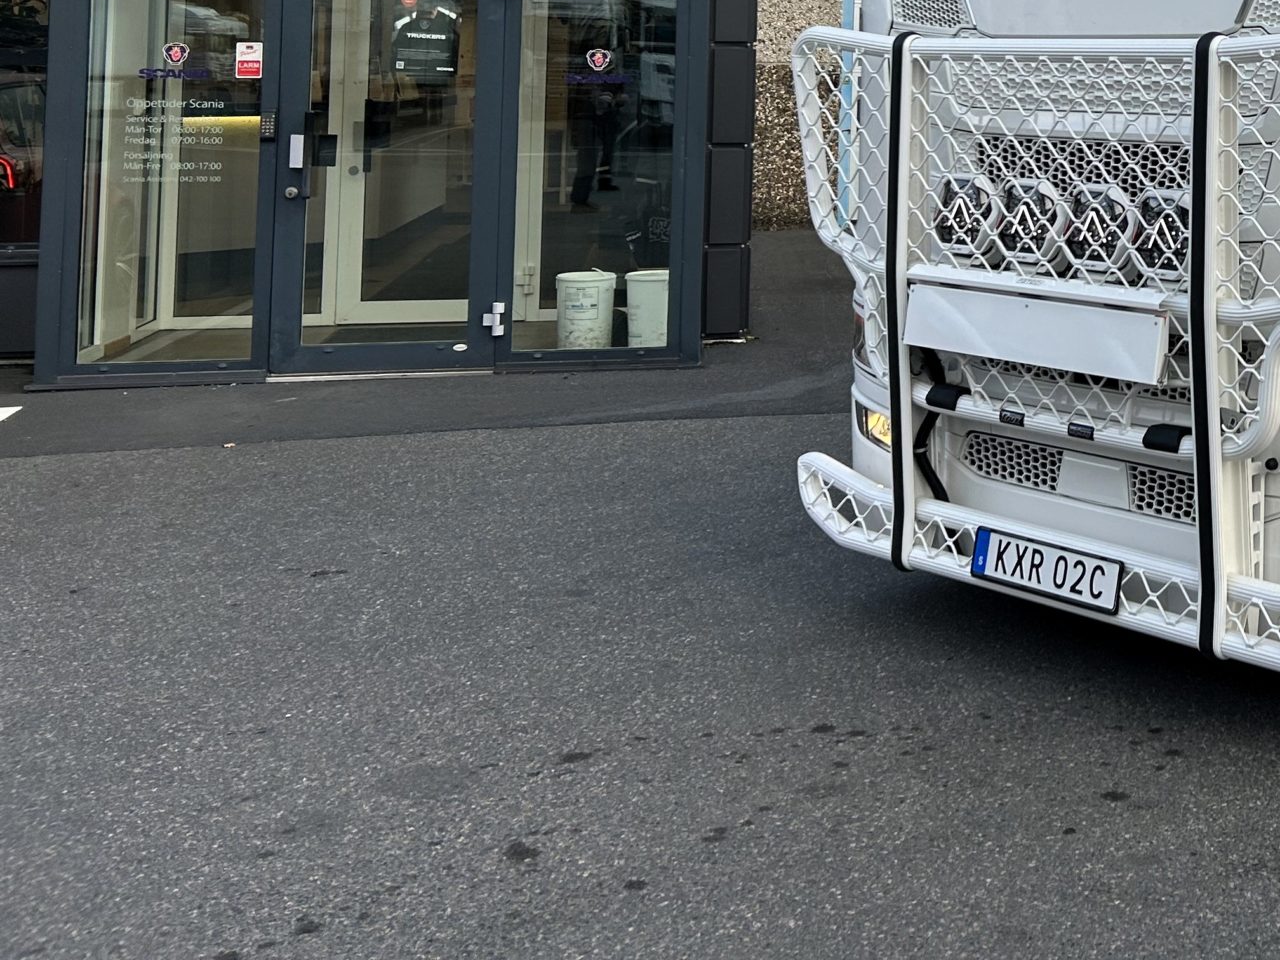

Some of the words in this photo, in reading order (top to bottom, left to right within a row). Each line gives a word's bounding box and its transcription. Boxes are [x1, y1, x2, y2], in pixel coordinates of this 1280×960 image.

[406, 32, 447, 40] TRUCKERS
[189, 98, 225, 109] Scania
[125, 114, 158, 123] Service
[124, 136, 157, 146] Fredag
[978, 555, 984, 566] S
[994, 538, 1044, 585] KXR
[1053, 555, 1106, 600] 02C
